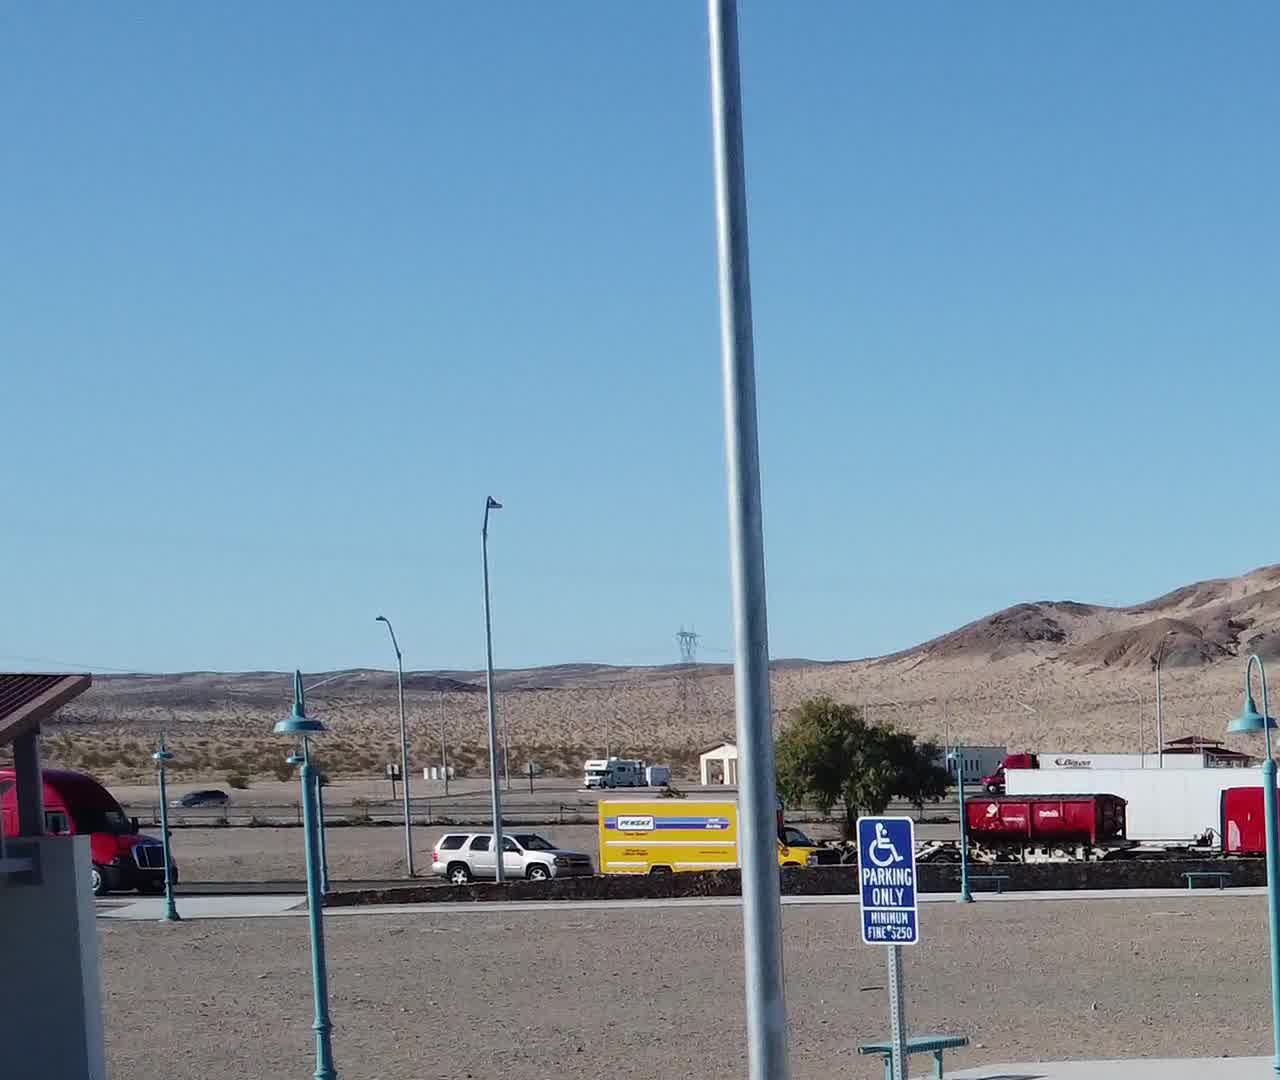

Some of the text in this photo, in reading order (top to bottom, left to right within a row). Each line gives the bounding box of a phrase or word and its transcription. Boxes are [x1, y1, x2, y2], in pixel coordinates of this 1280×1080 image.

[863, 867, 912, 886] PARKING
[872, 888, 904, 905] ONLY
[871, 911, 909, 924] MINIMUM
[867, 926, 913, 939] FINE $250
